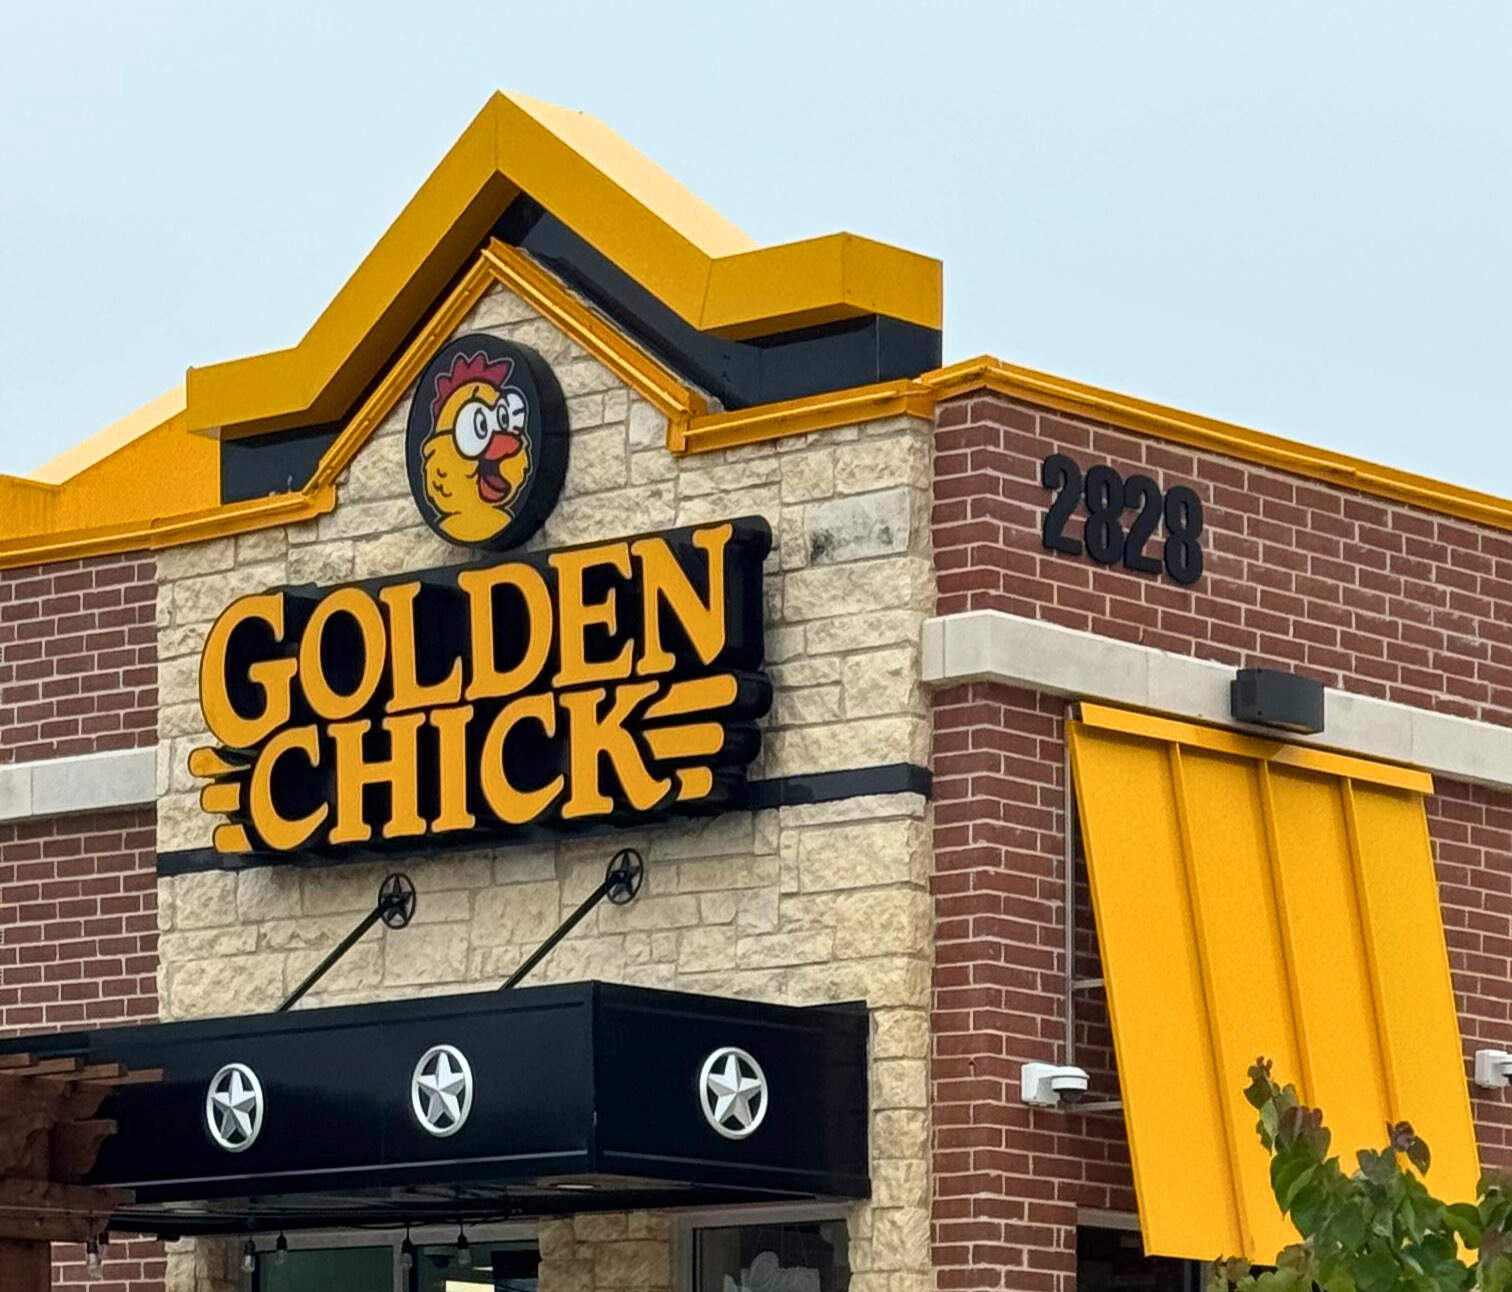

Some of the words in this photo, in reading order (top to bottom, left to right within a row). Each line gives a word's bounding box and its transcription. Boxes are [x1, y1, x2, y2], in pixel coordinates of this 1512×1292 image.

[1042, 454, 1204, 585] 2828
[200, 523, 733, 748] GOLDEN
[250, 682, 672, 852] CHICK
